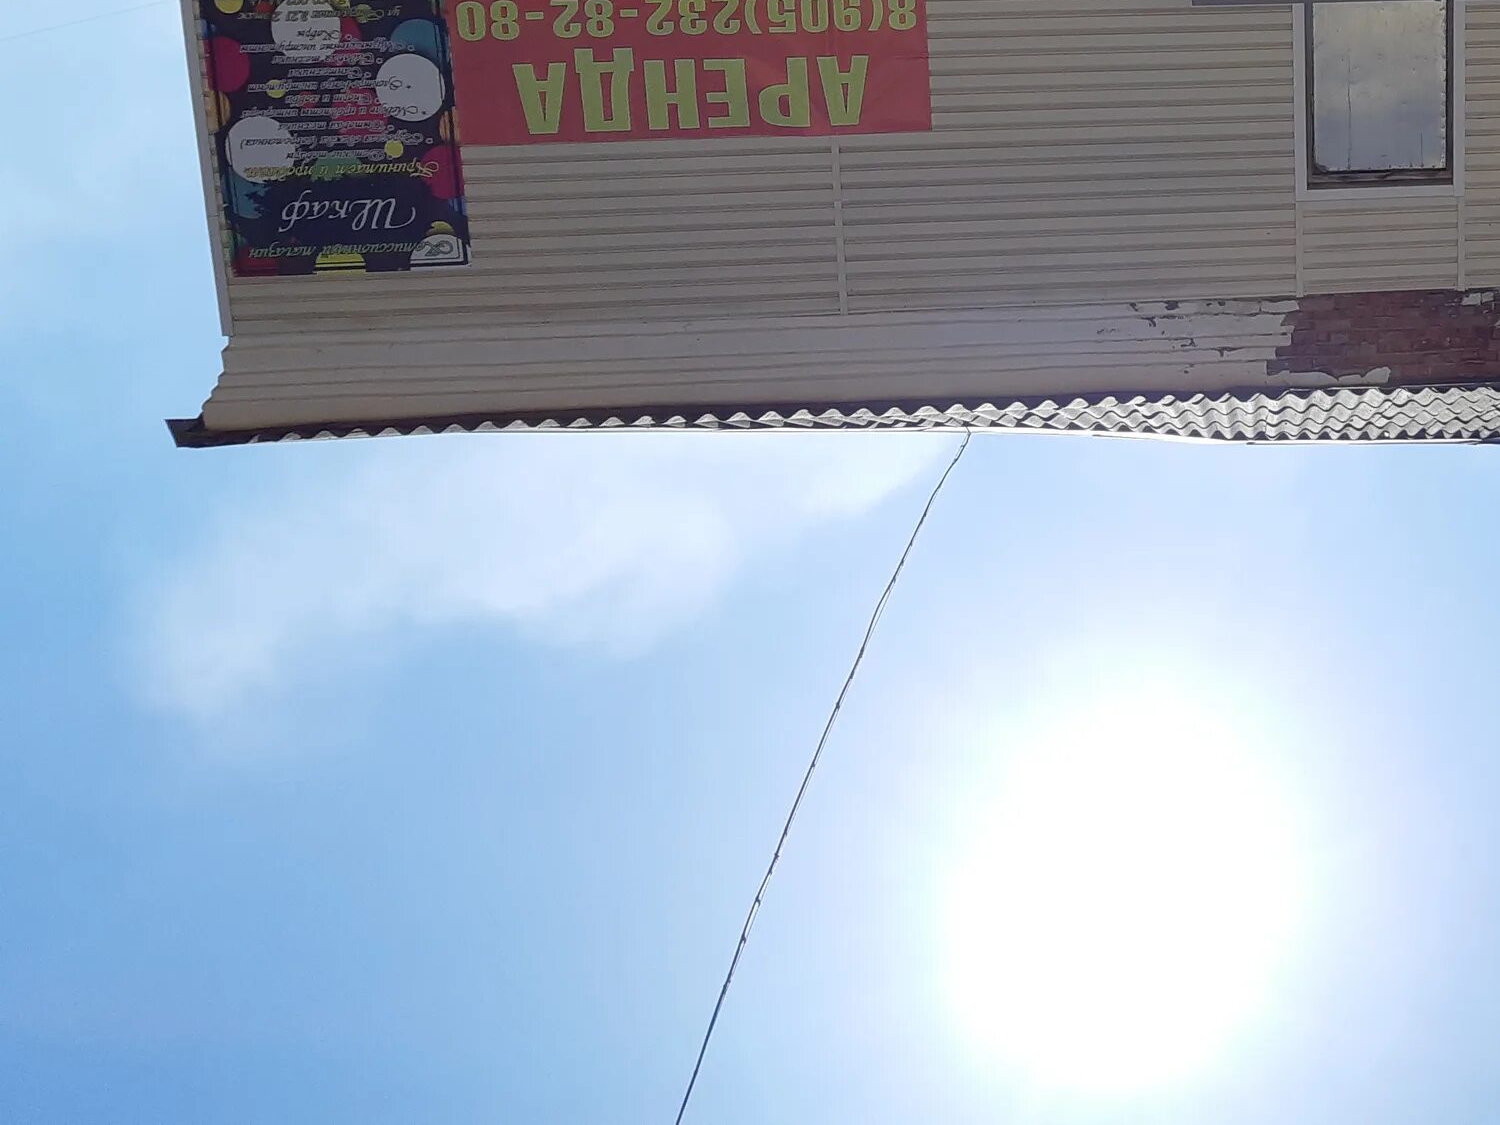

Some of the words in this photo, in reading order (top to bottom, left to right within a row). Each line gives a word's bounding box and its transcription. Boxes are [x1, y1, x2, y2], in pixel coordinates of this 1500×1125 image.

[296, 27, 340, 41] Ковры
[511, 46, 870, 135] АРЕНДА
[336, 158, 439, 177] Принимаем
[278, 189, 416, 232] Шкаф
[249, 241, 316, 258] магазин
